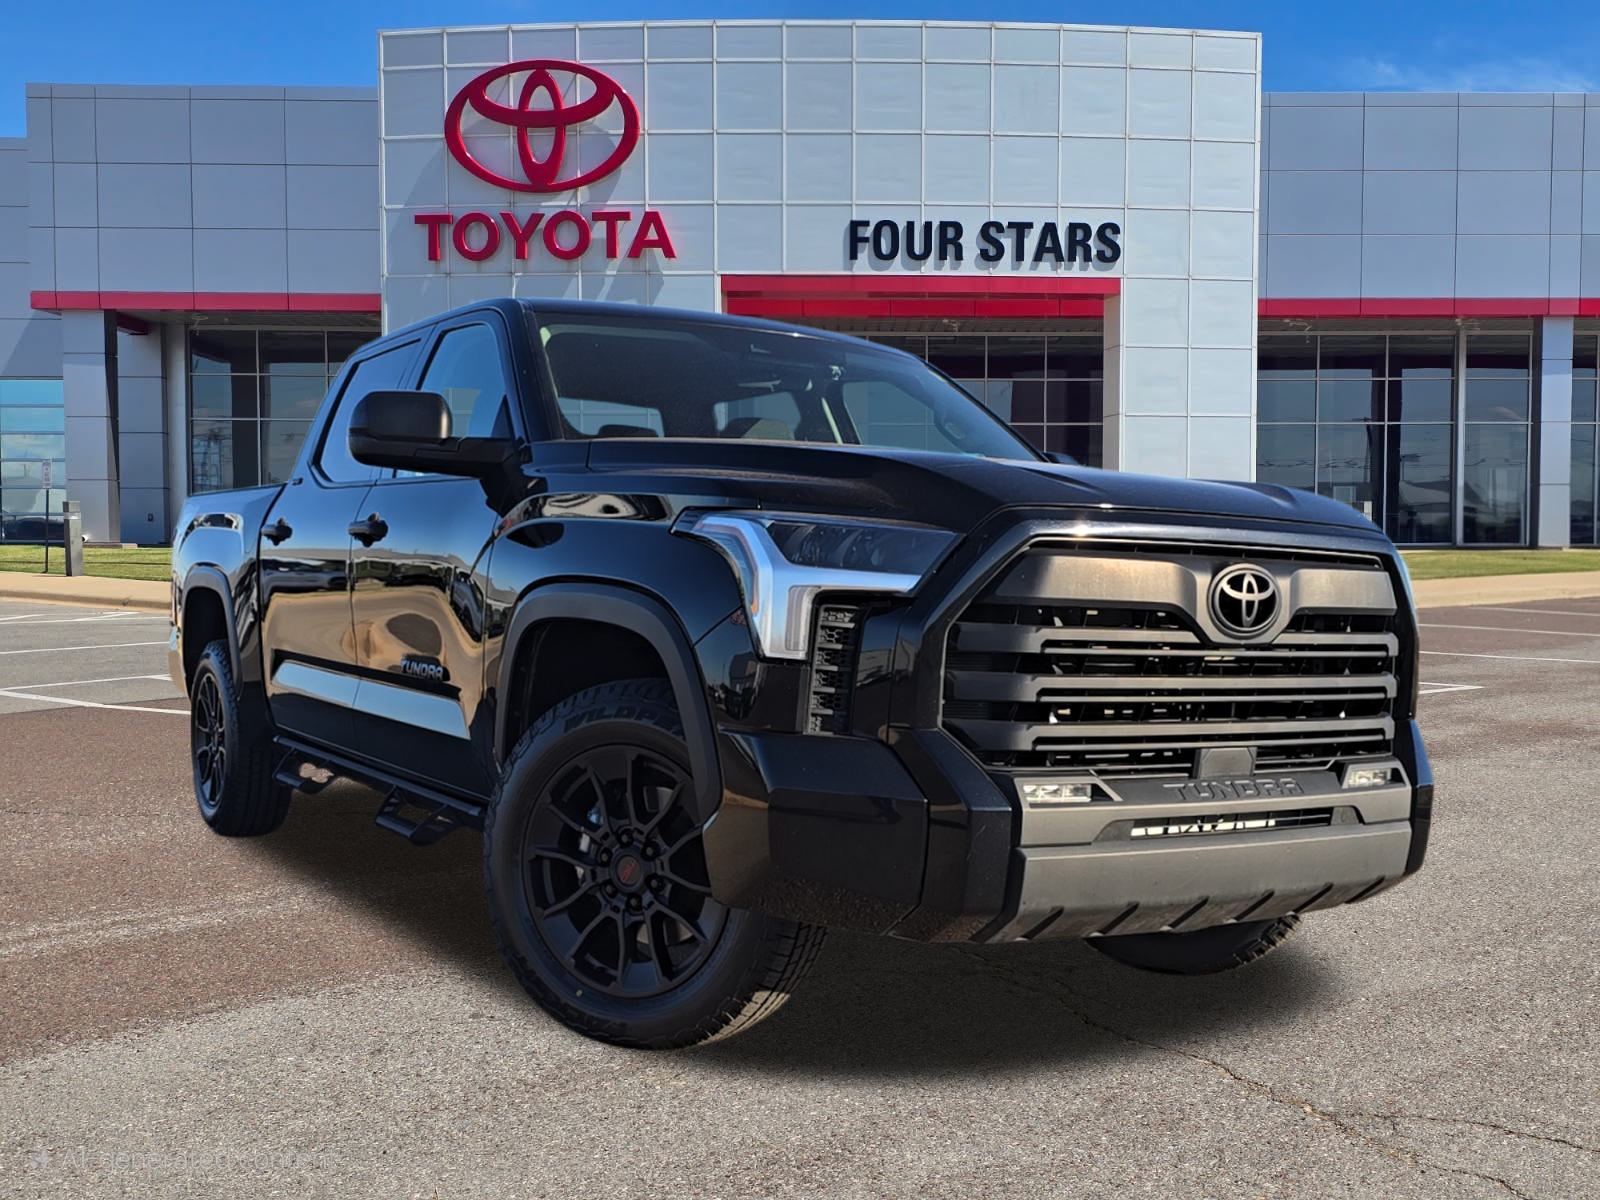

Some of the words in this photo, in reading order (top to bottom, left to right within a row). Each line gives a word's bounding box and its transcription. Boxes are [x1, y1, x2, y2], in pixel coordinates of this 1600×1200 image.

[414, 210, 677, 262] TOYOTA
[849, 219, 964, 261] FOUR
[979, 220, 1121, 263] STARS
[401, 659, 444, 680] TUNDRA
[1162, 778, 1305, 800] TUNDRA
